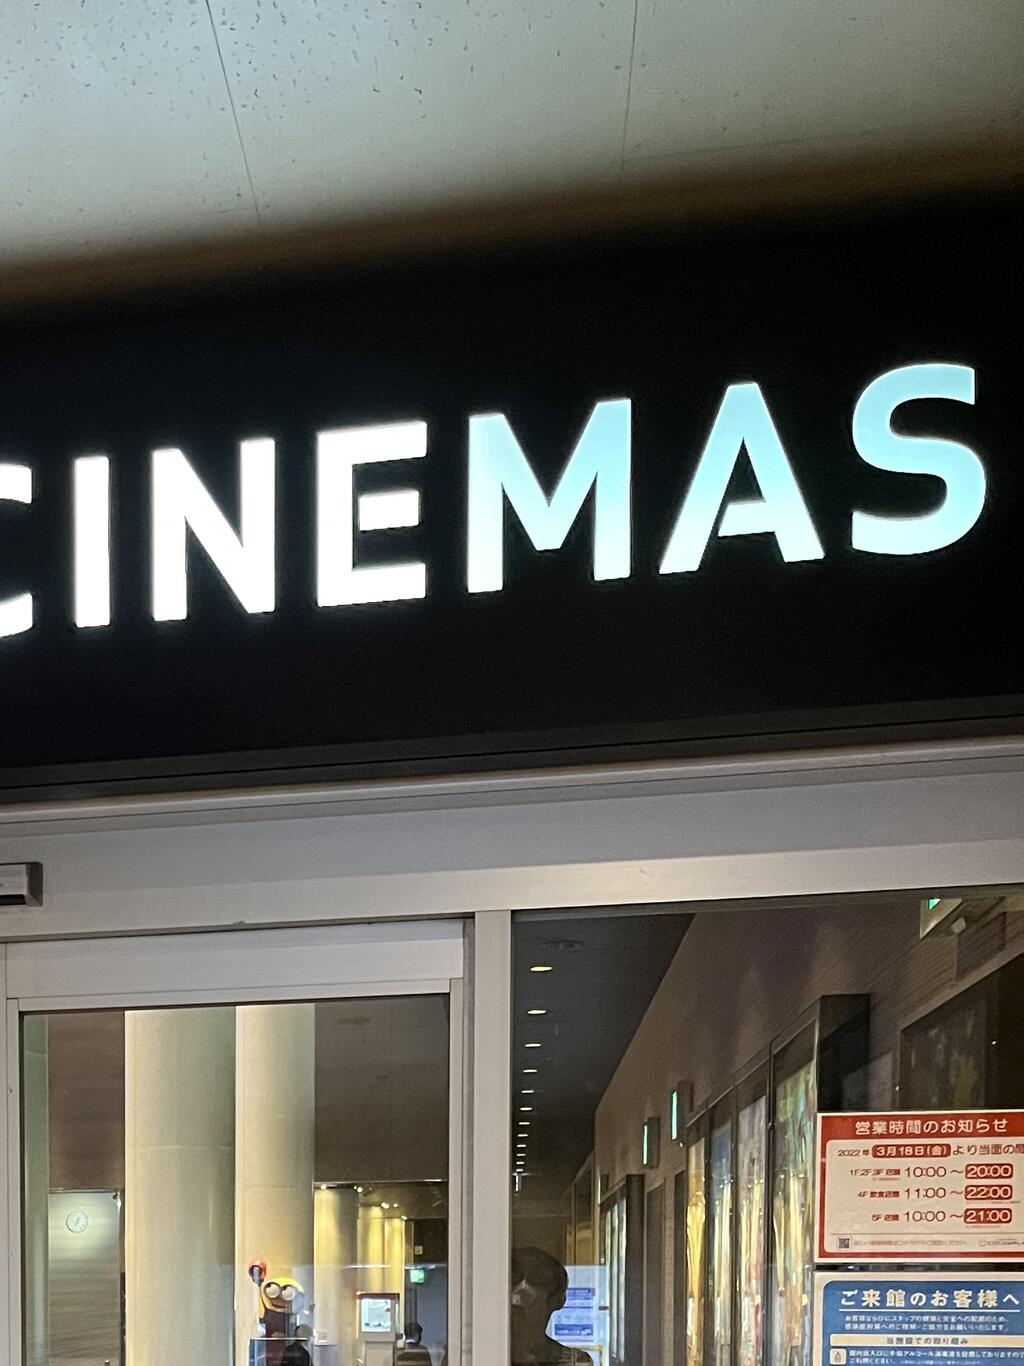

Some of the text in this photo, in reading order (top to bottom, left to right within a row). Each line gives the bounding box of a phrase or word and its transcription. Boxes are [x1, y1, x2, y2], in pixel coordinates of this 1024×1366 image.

[855, 1118, 1009, 1135] 営業時間のお知らせ
[905, 1166, 947, 1177] 10:00
[966, 1165, 1012, 1178] 20:00
[904, 1187, 947, 1199] 11:00
[966, 1186, 1012, 1199] 22:00
[905, 1211, 946, 1223] 10:00
[966, 1210, 1011, 1222] 21:00
[840, 1288, 1020, 1309] ご来館のお客様へ
